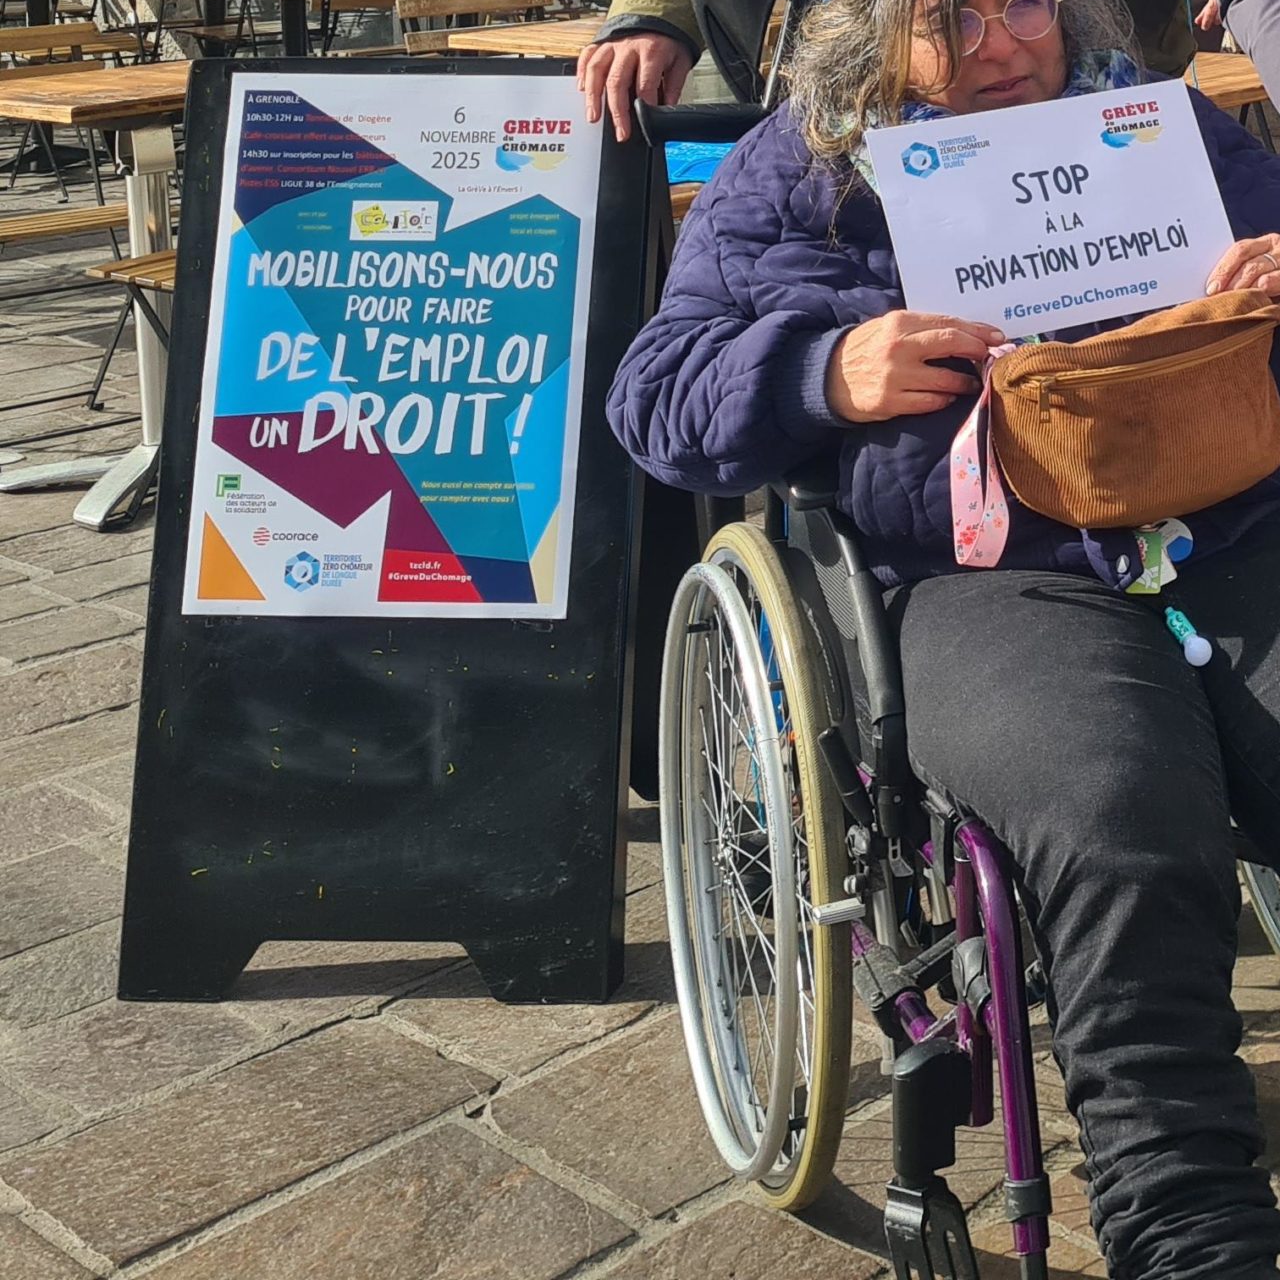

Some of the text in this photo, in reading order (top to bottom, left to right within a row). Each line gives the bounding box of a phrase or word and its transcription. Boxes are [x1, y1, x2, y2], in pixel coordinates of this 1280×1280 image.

[255, 95, 300, 104] GRENOBLE
[246, 113, 292, 122] 10h30-12H
[293, 114, 304, 122] au
[358, 114, 392, 124] Diogène
[454, 106, 466, 124] 6
[1102, 101, 1159, 120] GRÈVE
[503, 117, 572, 135] GRÈVE
[1106, 119, 1160, 134] CHÔMAGE
[420, 130, 496, 144] NOVEMBRE
[242, 149, 269, 158] 14h30
[283, 151, 322, 160] inscription
[322, 151, 341, 160] pour
[341, 150, 354, 159] les
[502, 141, 565, 152] CHÔMAGE
[431, 151, 481, 169] 2025
[280, 180, 303, 188] LIGUE
[304, 180, 315, 188] 38
[1011, 163, 1090, 205] STOP
[1045, 211, 1085, 234] À LA
[247, 250, 558, 289] MOBILISONS-NOUS
[1003, 278, 1159, 321] #GreveDuChomage
[345, 295, 494, 325] POUR FAIRE
[256, 327, 549, 384] DE L'EMPLOI
[249, 416, 289, 449] UN
[297, 391, 508, 456] DROIT
[272, 533, 319, 542] coorace
[340, 561, 373, 570] CHÔMEUR
[388, 573, 472, 582] #GreveDuChomage
